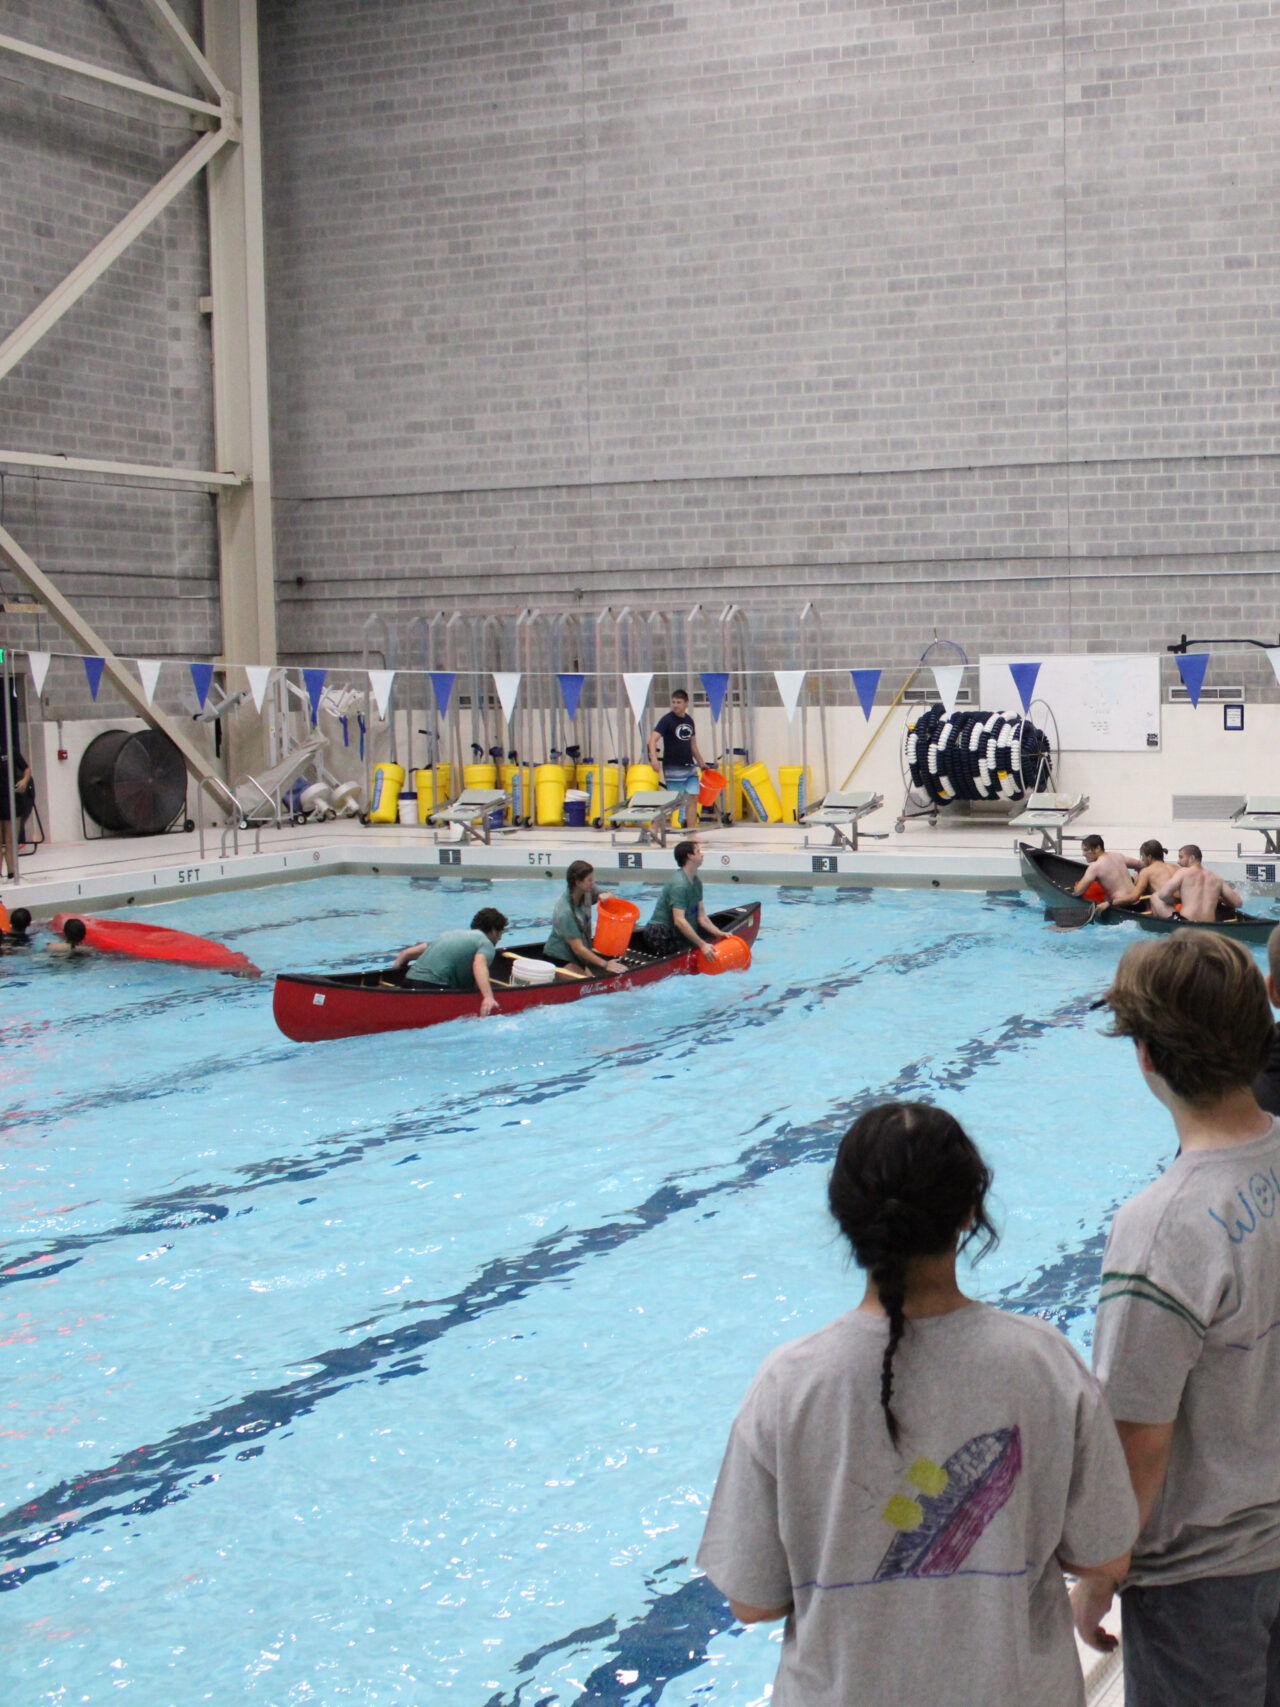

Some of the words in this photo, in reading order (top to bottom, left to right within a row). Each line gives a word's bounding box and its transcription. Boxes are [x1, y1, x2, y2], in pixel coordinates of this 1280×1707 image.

[627, 854, 635, 867] 2
[821, 857, 830, 871] 3
[1257, 866, 1267, 881] 5
